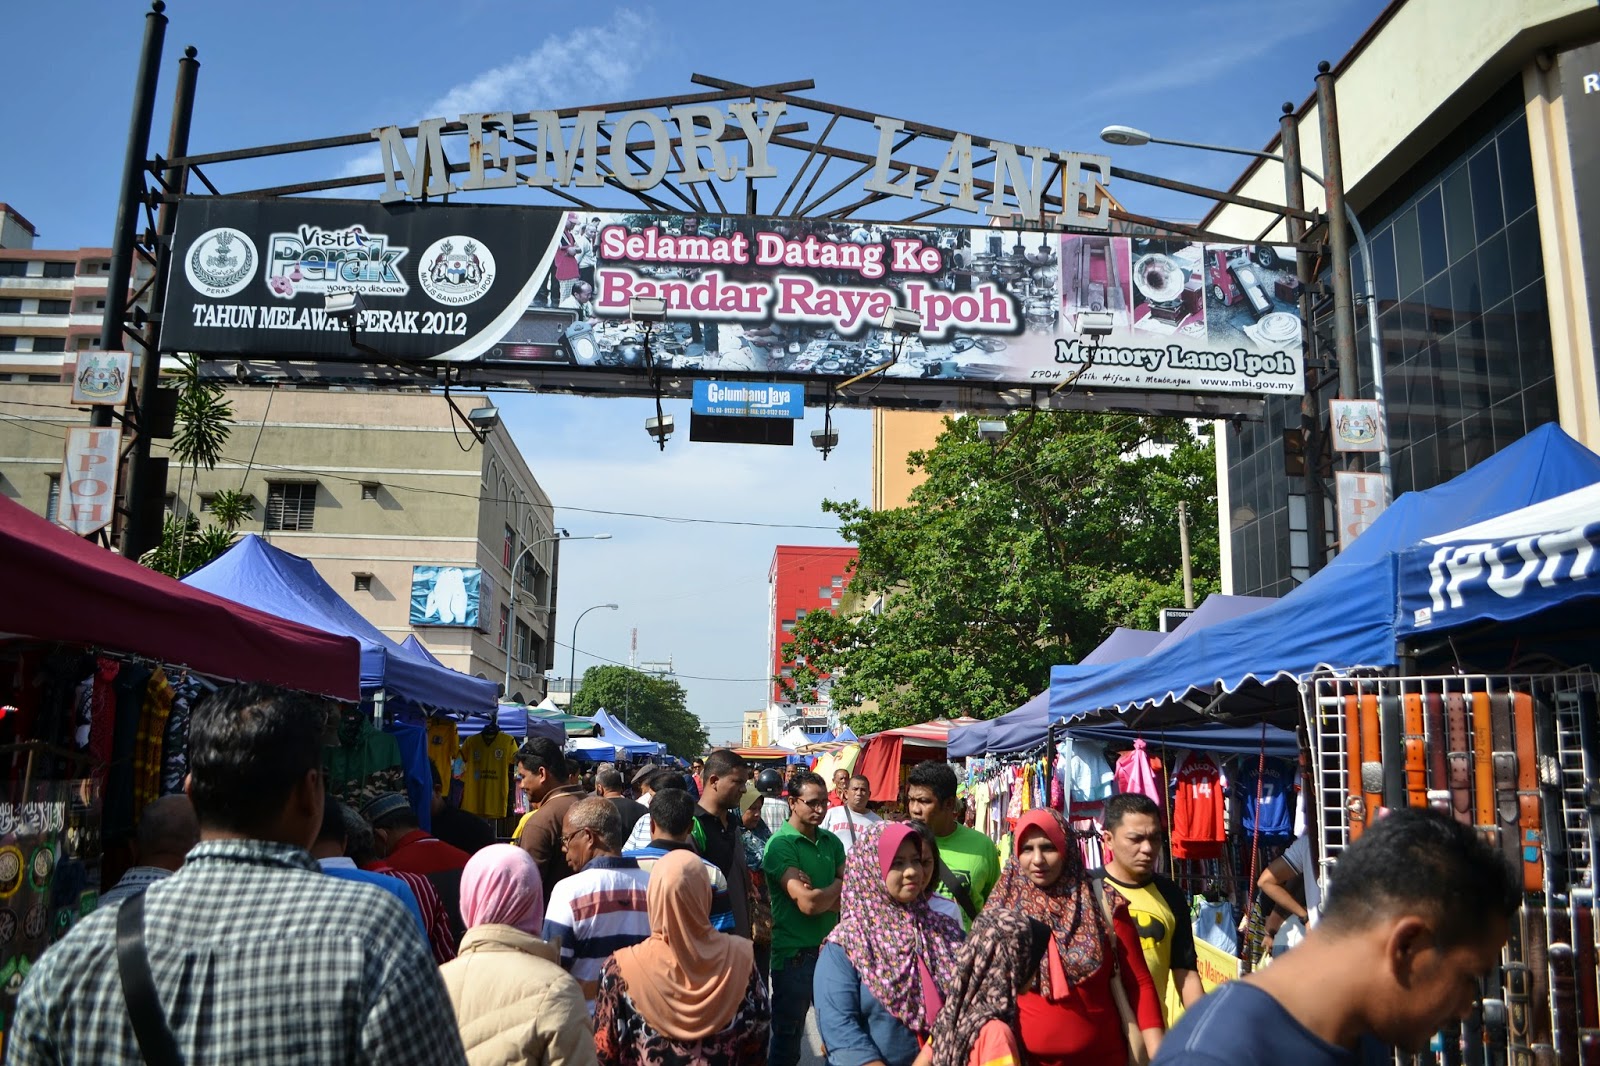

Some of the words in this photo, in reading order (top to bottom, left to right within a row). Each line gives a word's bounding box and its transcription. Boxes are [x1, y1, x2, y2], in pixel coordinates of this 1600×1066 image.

[371, 101, 787, 203] MEMORY
[863, 116, 1111, 229] LANE
[301, 227, 354, 247] Visit
[602, 225, 748, 263] Selamat
[757, 231, 885, 278] Datang
[891, 238, 941, 272] Ke
[270, 236, 407, 283] Perak
[205, 286, 231, 295] PERAK
[368, 284, 406, 294] discover
[420, 272, 437, 296] MAJLIS
[435, 290, 482, 303] BANDARAYA
[480, 273, 494, 292] IPOH
[597, 270, 769, 313] Bandar
[777, 277, 893, 329] Raya
[906, 283, 1012, 333] Ipoh
[192, 303, 258, 329] TAHUN
[355, 309, 420, 334] PERAK
[421, 311, 468, 335] 2012
[1054, 338, 1165, 371] Memory
[1167, 345, 1232, 371] Lane
[1232, 348, 1297, 376] Ipoh
[1030, 370, 1061, 379] IPOH
[1200, 376, 1295, 391] www.mbi.gov.my
[707, 382, 767, 403] Gelumbang
[758, 387, 790, 407] Jaya
[64, 431, 108, 522] IPOH
[1190, 776, 1212, 799] 14
